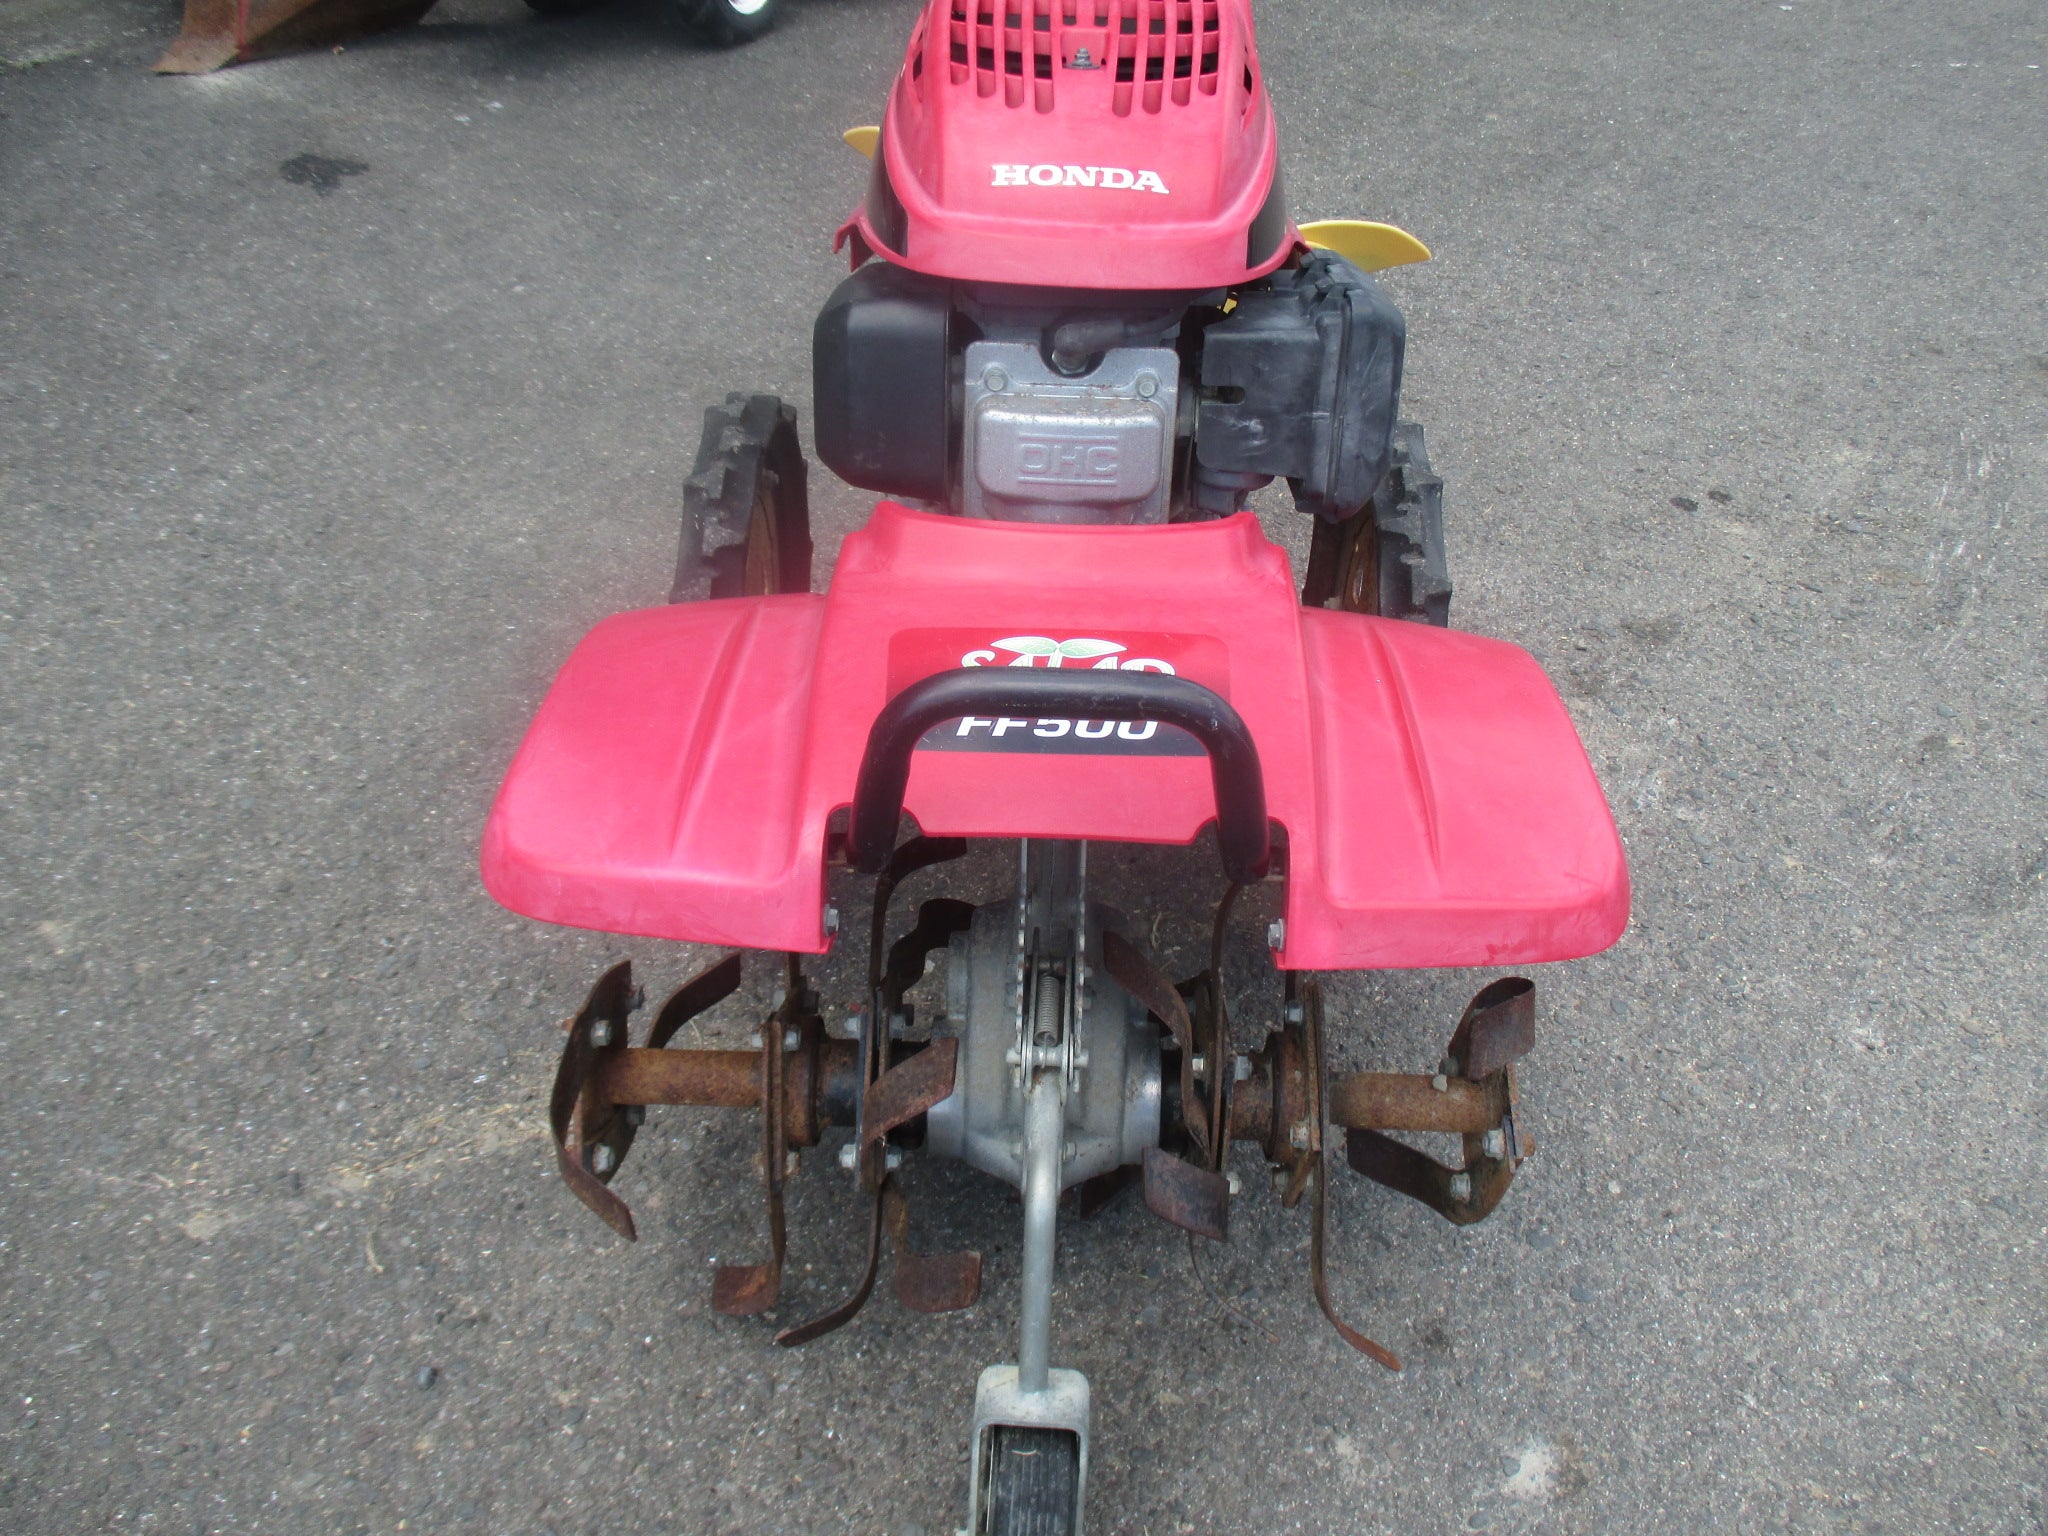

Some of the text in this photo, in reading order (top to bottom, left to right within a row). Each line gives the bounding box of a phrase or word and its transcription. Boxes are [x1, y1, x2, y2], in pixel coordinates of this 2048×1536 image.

[991, 164, 1170, 195] HONDA
[1018, 442, 1120, 476] OHC
[955, 716, 1159, 740] FF500
